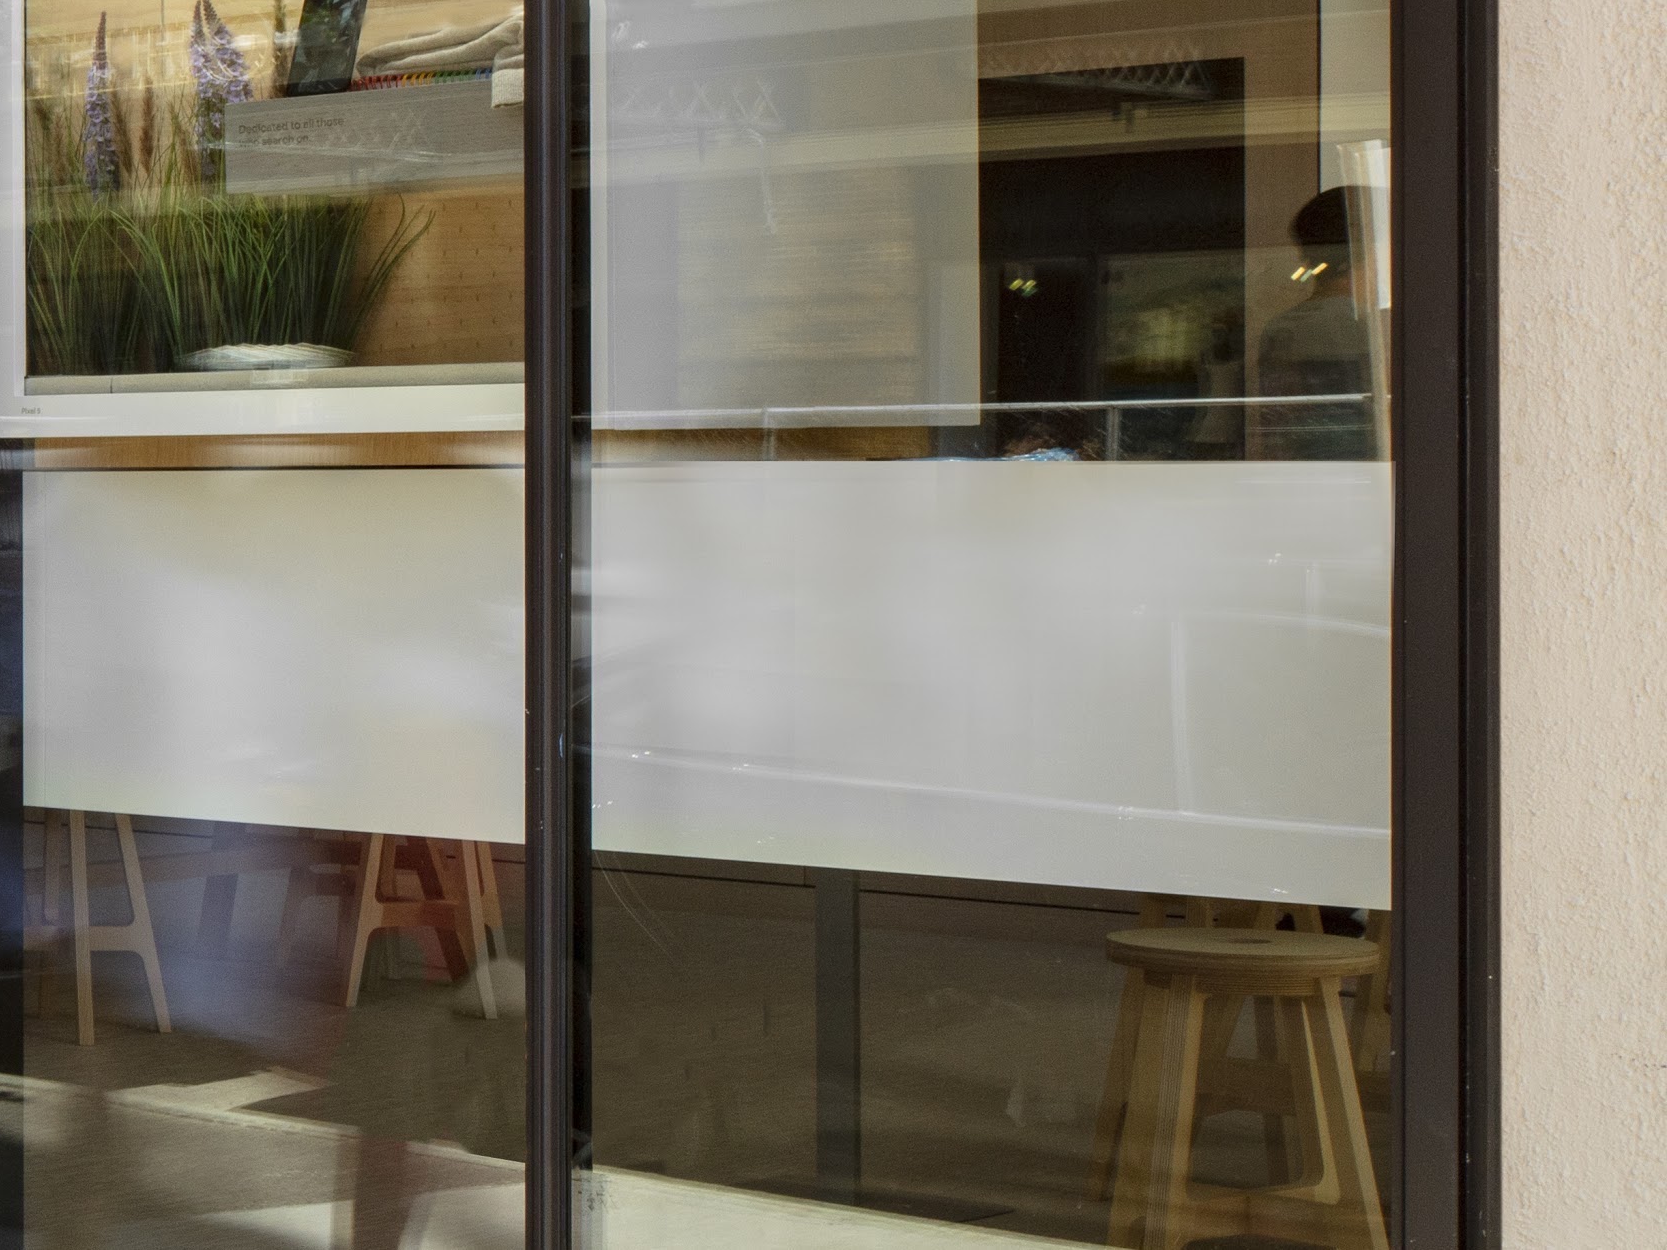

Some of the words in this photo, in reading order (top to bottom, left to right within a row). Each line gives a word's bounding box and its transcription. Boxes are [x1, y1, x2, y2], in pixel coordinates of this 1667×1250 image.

[238, 120, 288, 134] Dedicated
[290, 121, 301, 130] to
[316, 116, 345, 128] those
[261, 134, 294, 146] search
